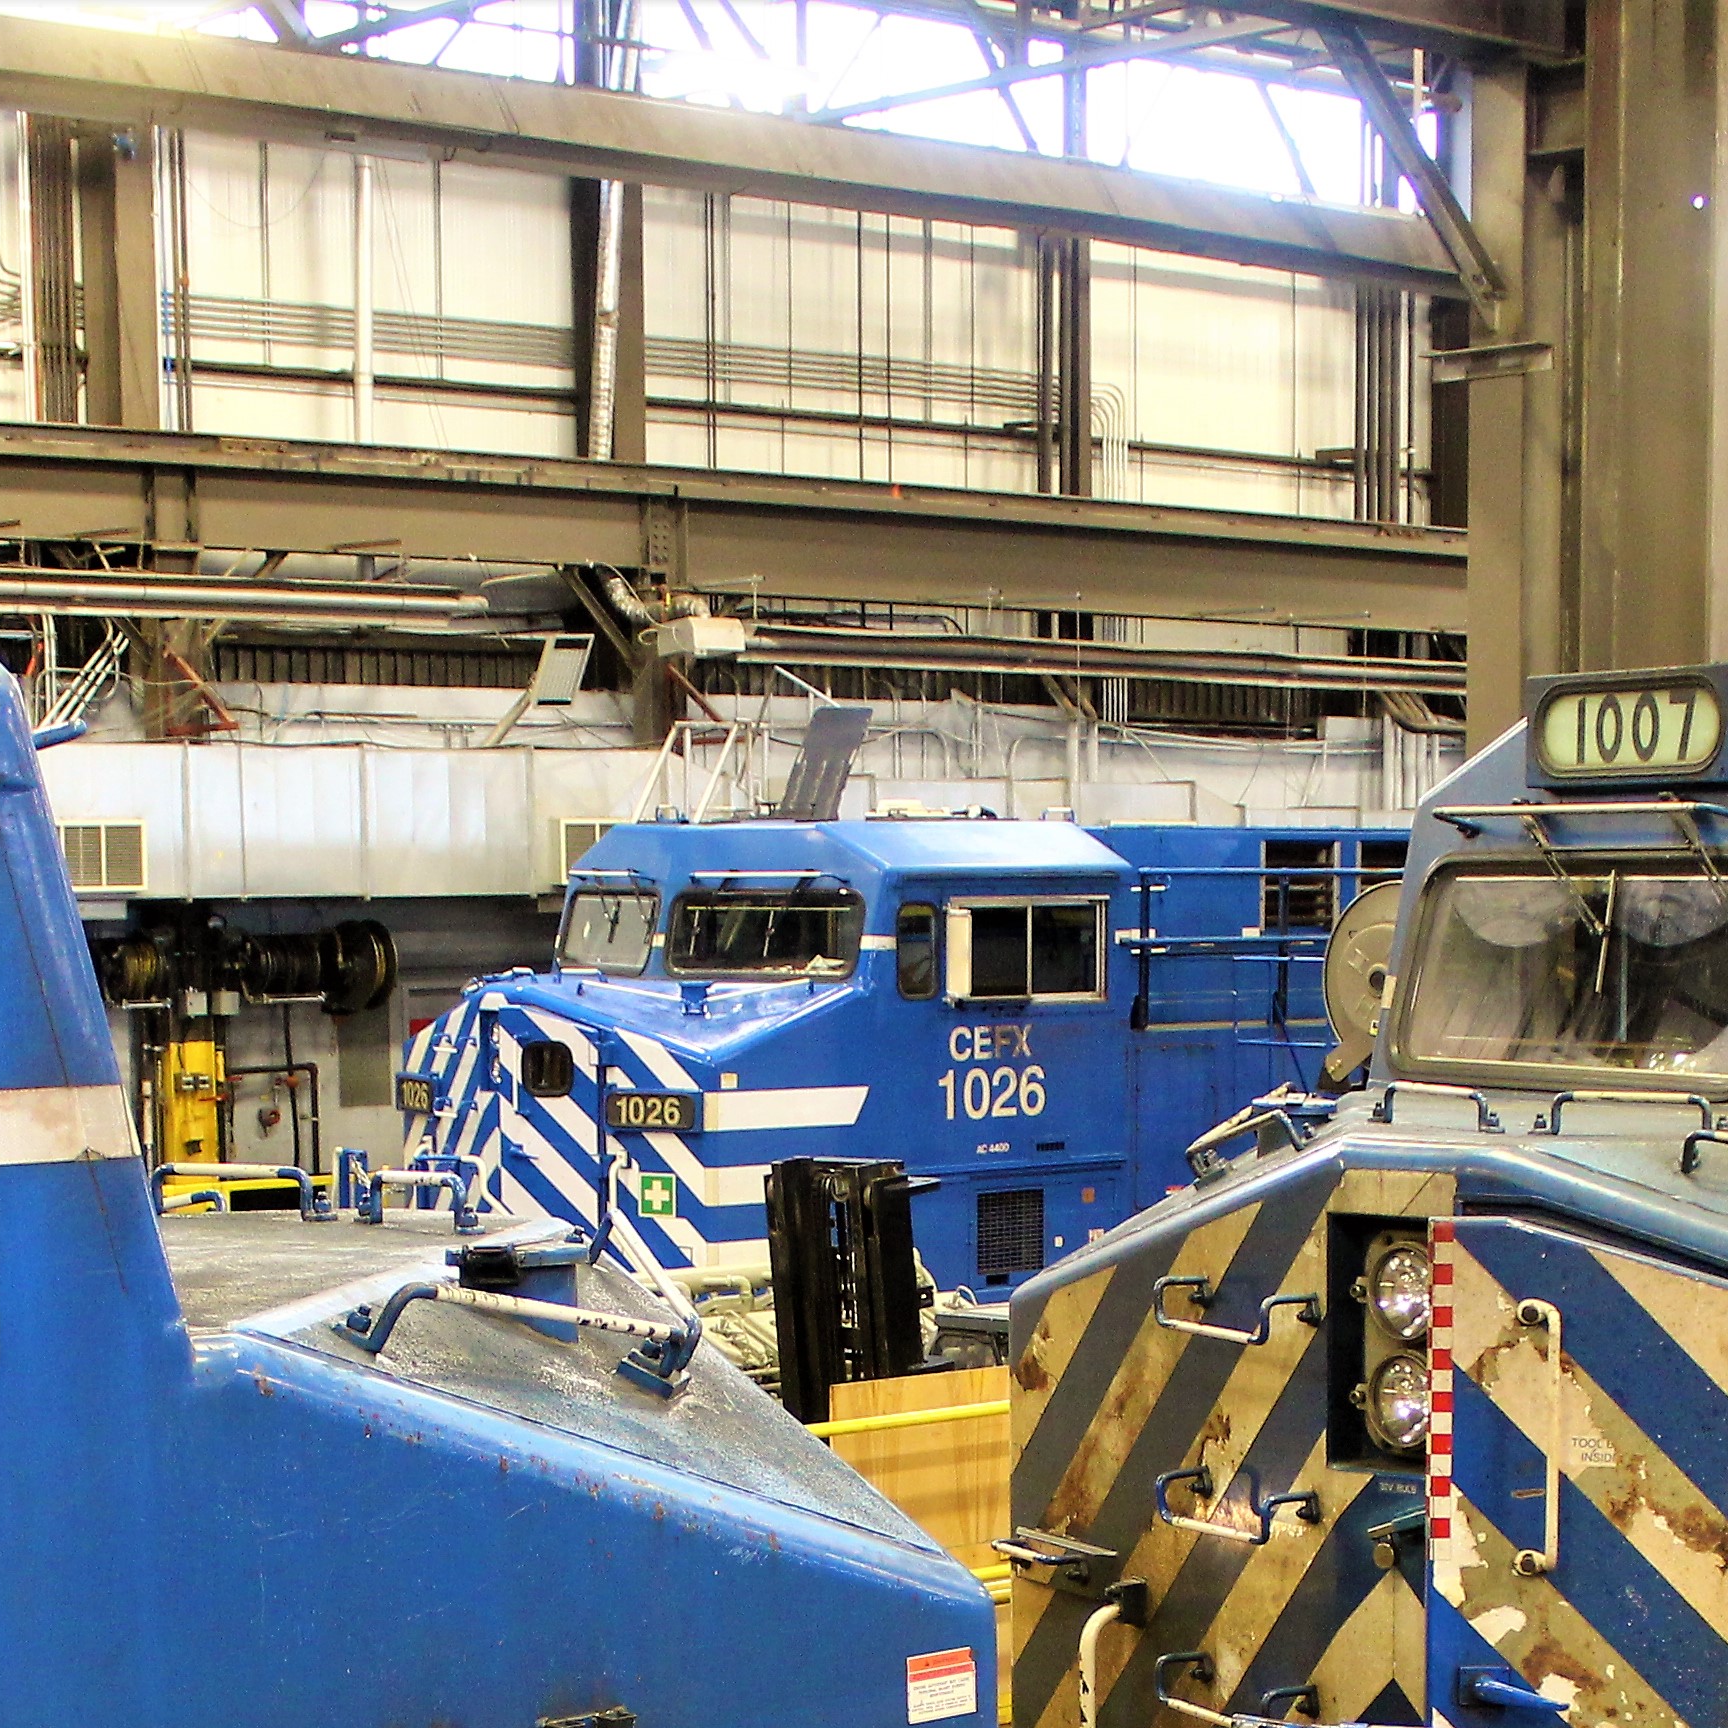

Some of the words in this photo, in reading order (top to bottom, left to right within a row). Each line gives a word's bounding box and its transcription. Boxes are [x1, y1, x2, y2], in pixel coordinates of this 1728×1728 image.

[1576, 687, 1697, 765] 1007
[948, 1023, 1033, 1062] CEFX
[401, 1078, 430, 1110] 1026
[938, 1064, 1046, 1121] 1026
[616, 1095, 682, 1126] 1026
[1572, 1437, 1603, 1449] TOOL
[1581, 1452, 1615, 1463] INSID
